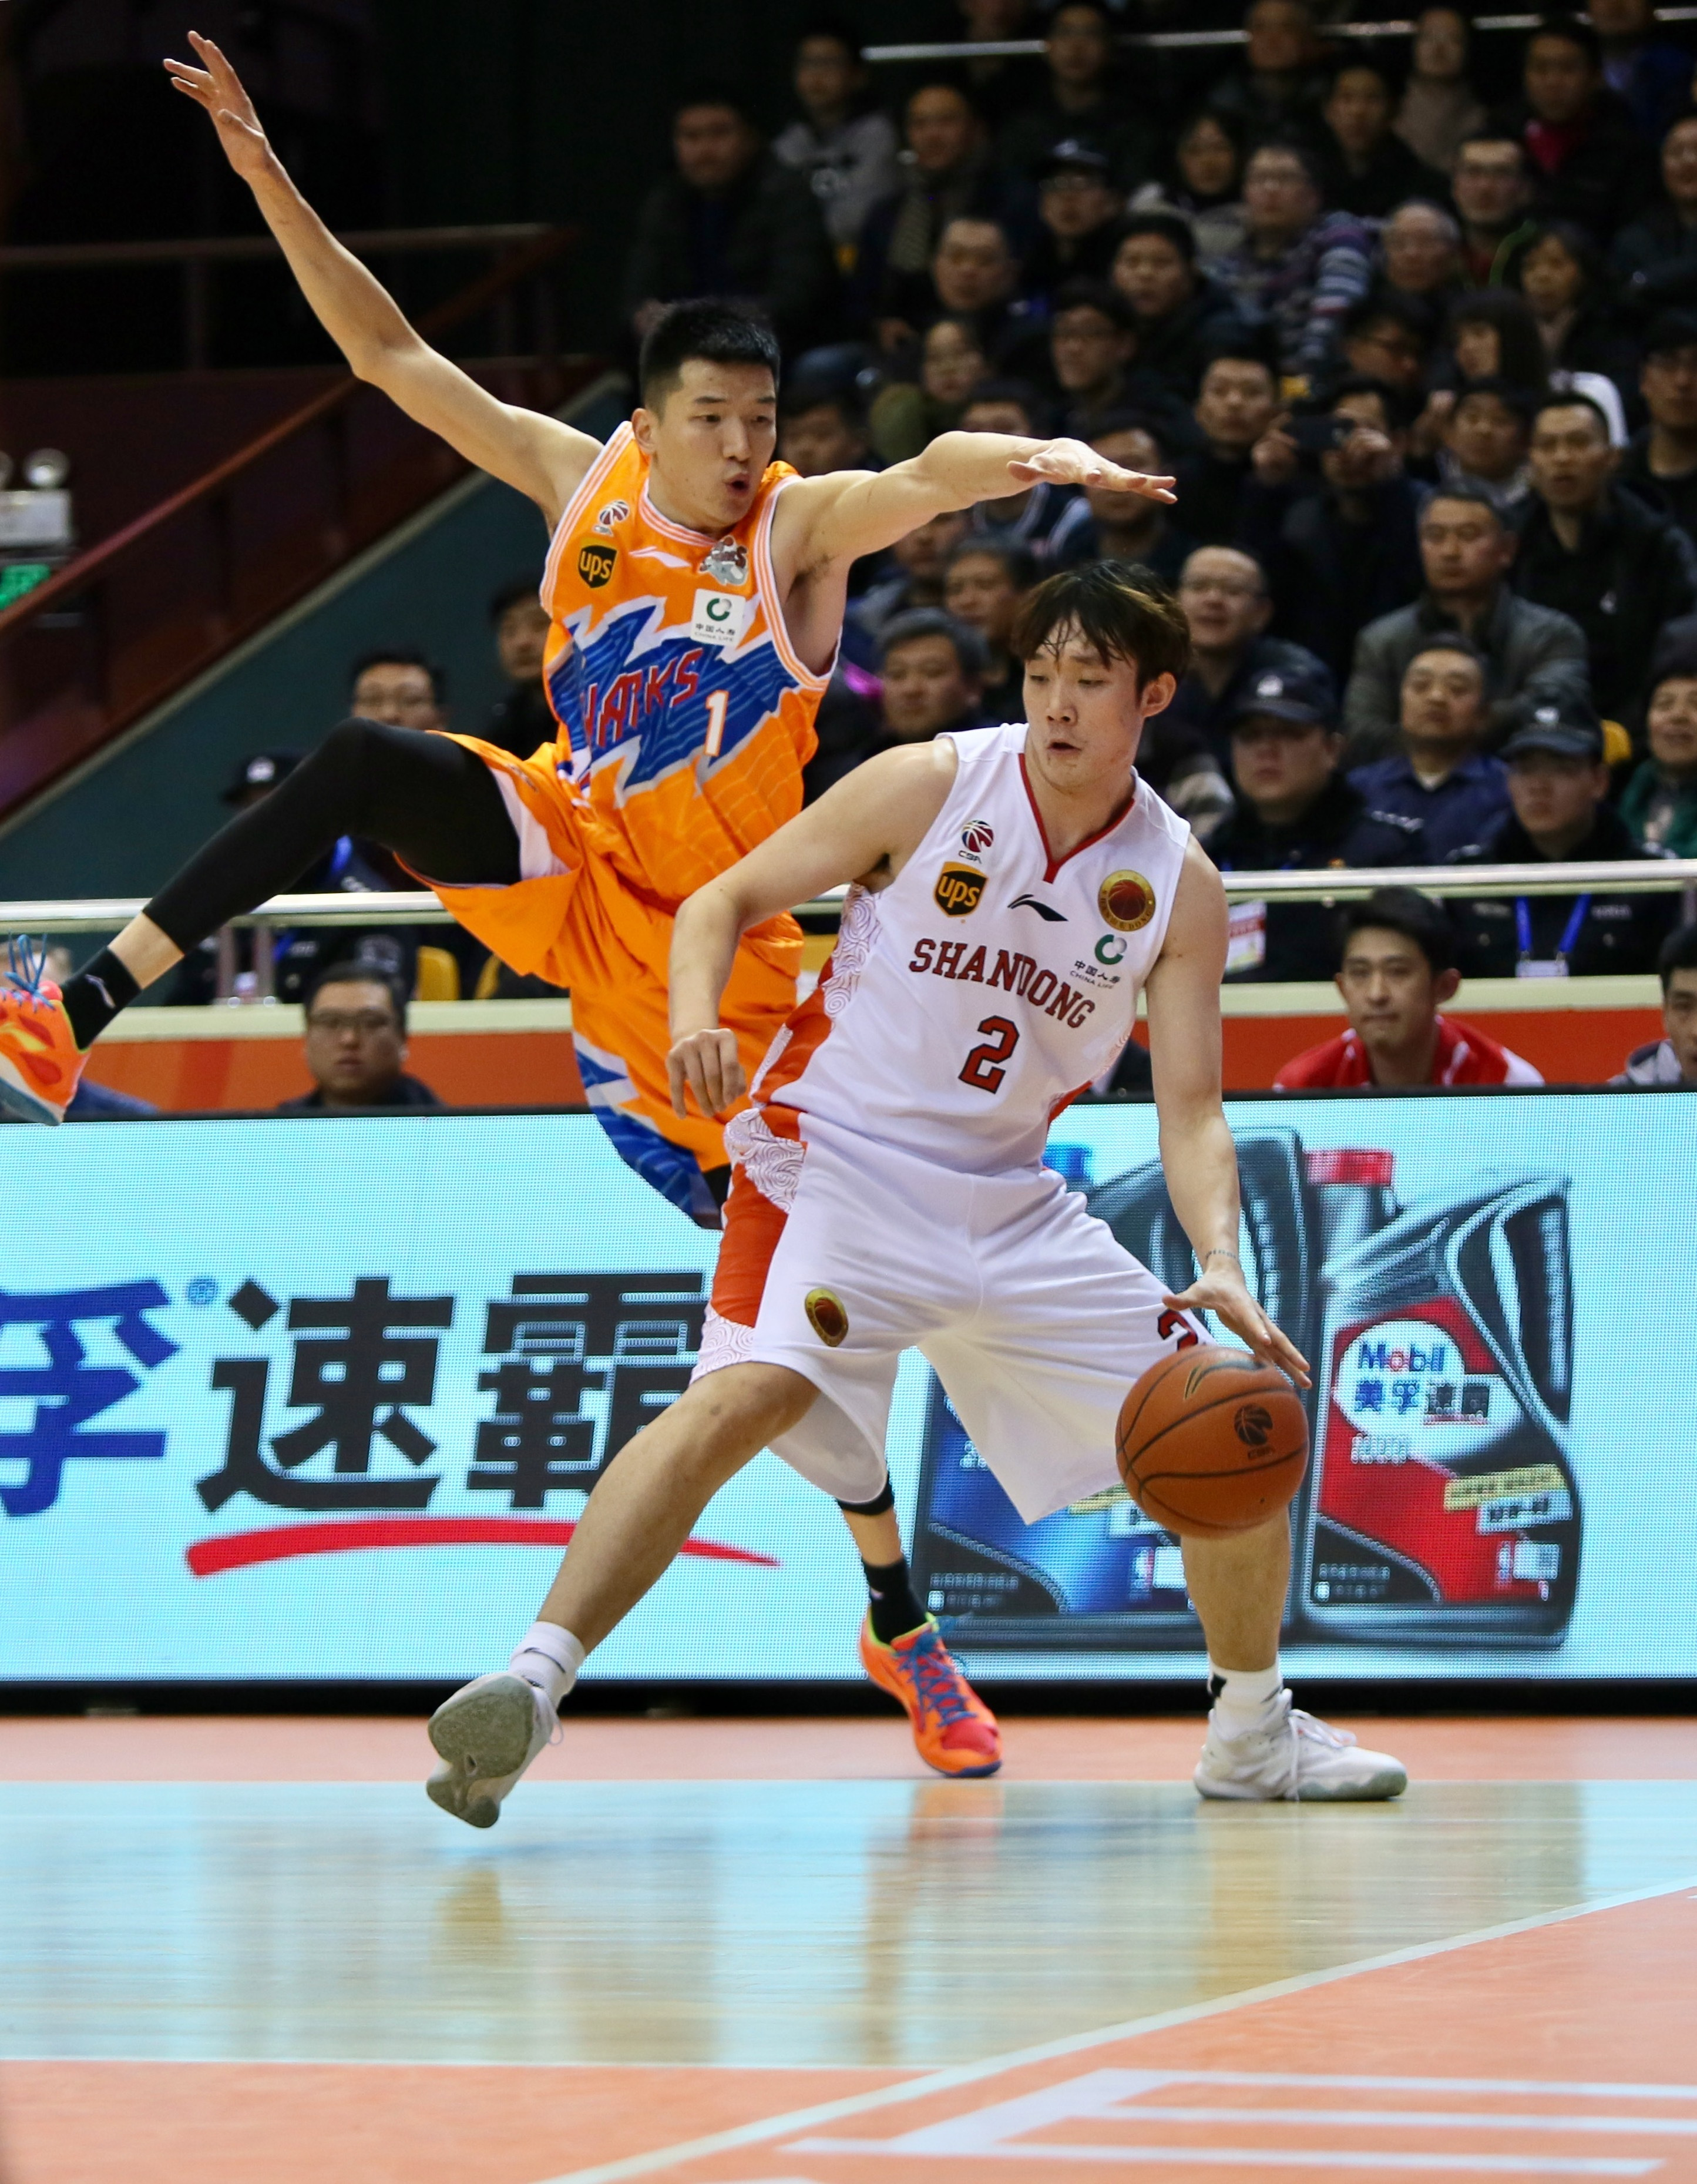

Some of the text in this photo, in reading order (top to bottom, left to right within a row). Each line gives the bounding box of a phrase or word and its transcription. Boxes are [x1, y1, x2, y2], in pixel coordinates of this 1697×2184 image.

[581, 552, 612, 580] ups
[705, 689, 730, 757] 1
[938, 874, 981, 910] ups
[909, 938, 1096, 1029] SHANDONG
[1070, 969, 1096, 985] CHINA
[957, 1015, 1020, 1095] 2
[1357, 1342, 1446, 1373] Mobil
